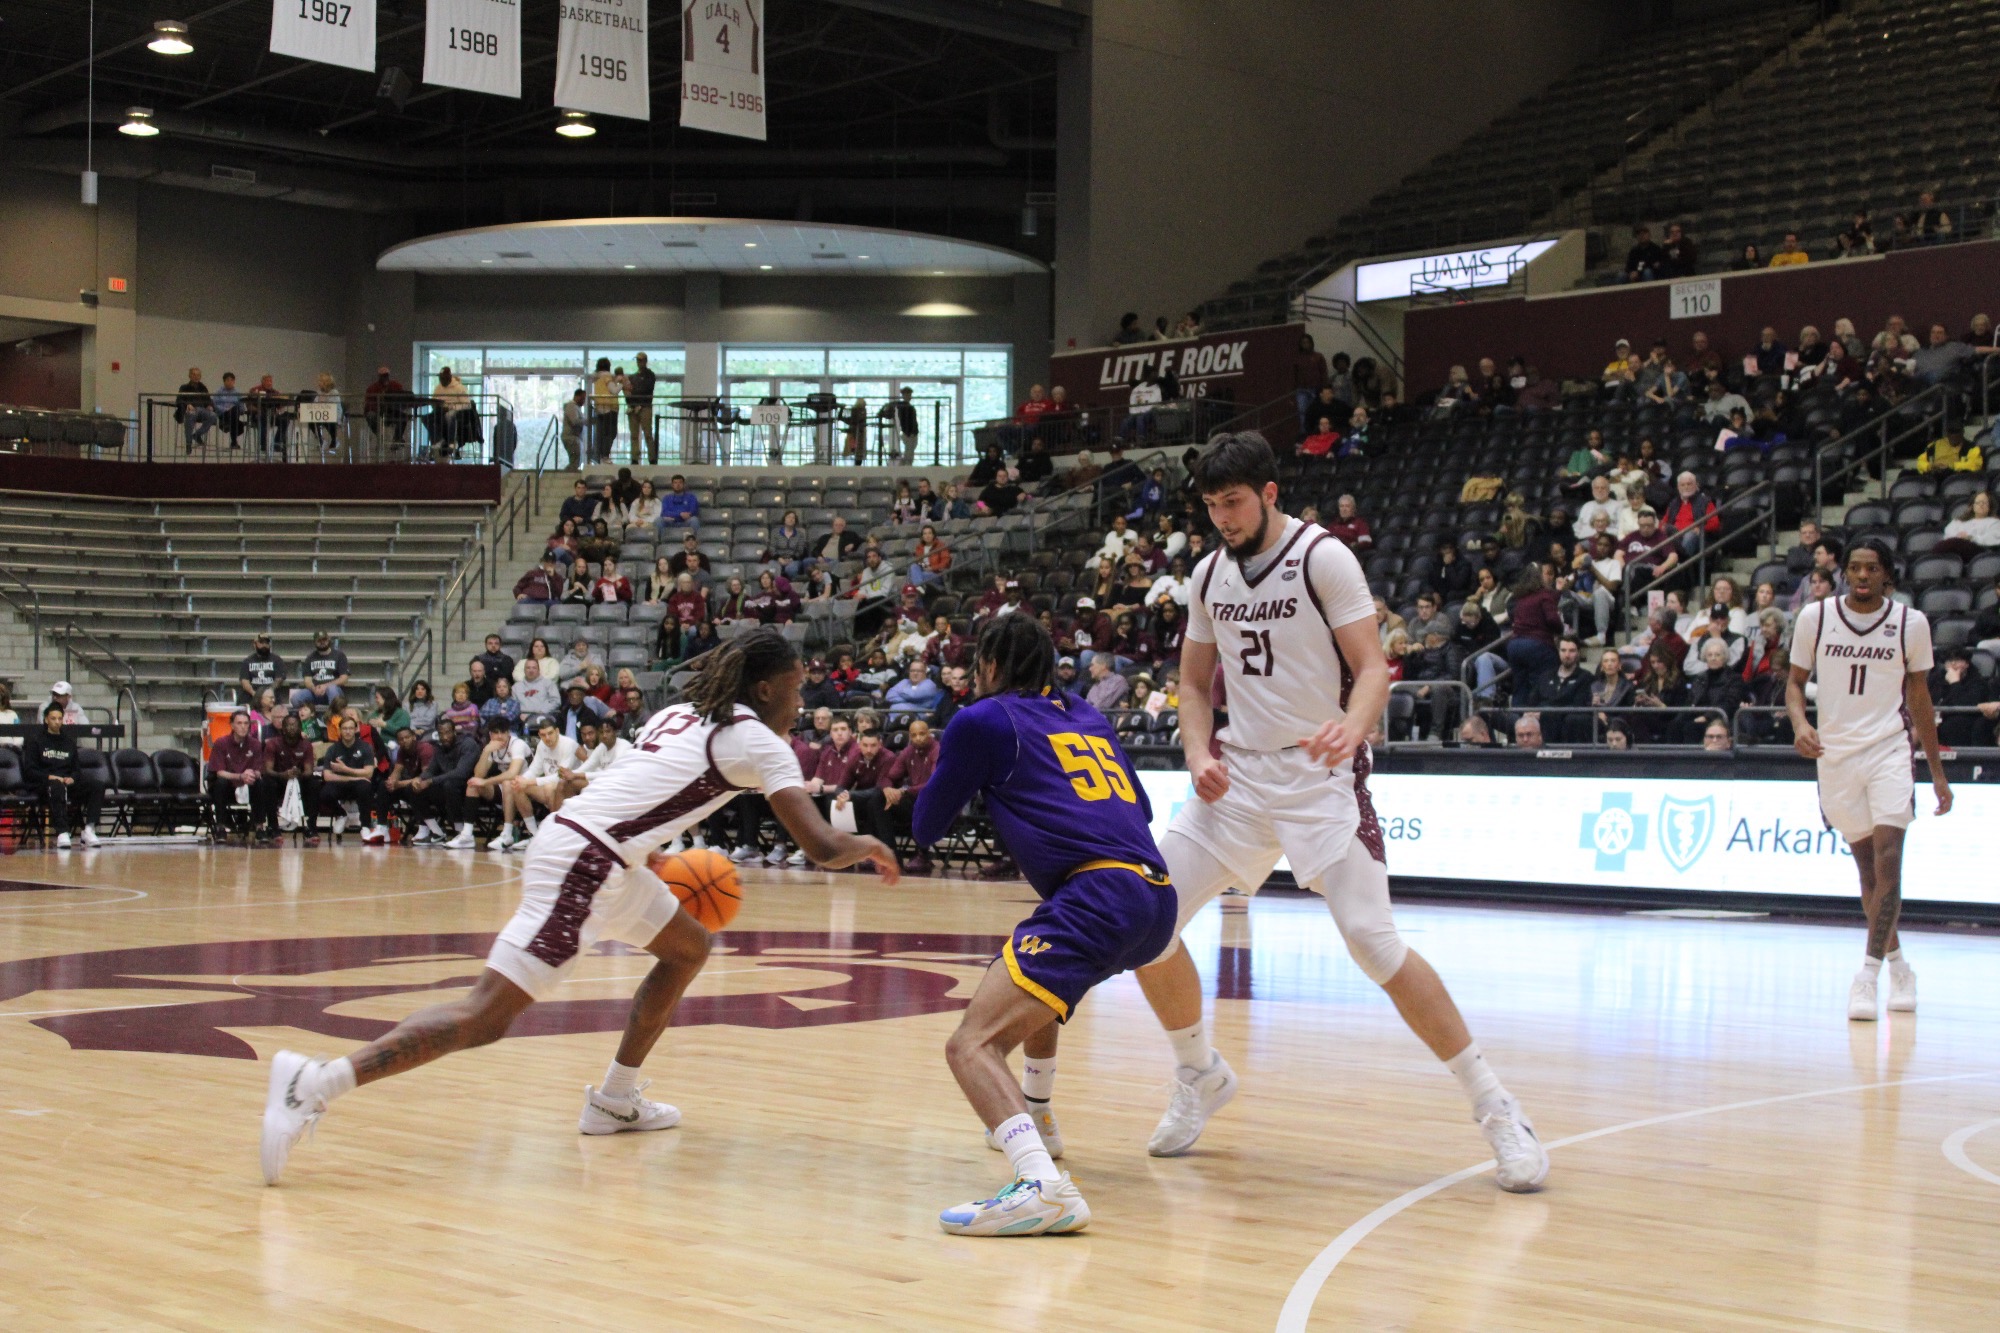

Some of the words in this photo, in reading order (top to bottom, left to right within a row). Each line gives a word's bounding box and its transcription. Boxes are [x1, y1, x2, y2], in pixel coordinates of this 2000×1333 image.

[299, 0, 351, 27] 1987
[560, 5, 643, 33] BASKETBALL
[706, 2, 740, 28] UALR
[449, 27, 498, 56] 1988
[716, 24, 729, 53] 4
[579, 54, 627, 81] 1996
[682, 83, 763, 113] 1992-1996
[1423, 251, 1491, 282] UAMS
[1682, 294, 1710, 314] 110
[1180, 341, 1248, 376] ROCK
[309, 411, 330, 421] 108
[760, 413, 780, 423] 109
[1212, 597, 1298, 622] TROJANS
[1240, 629, 1273, 677] 21
[1824, 644, 1895, 661] TROJANS
[1849, 664, 1867, 695] 11
[633, 711, 700, 754] 12
[1046, 732, 1137, 804] 55
